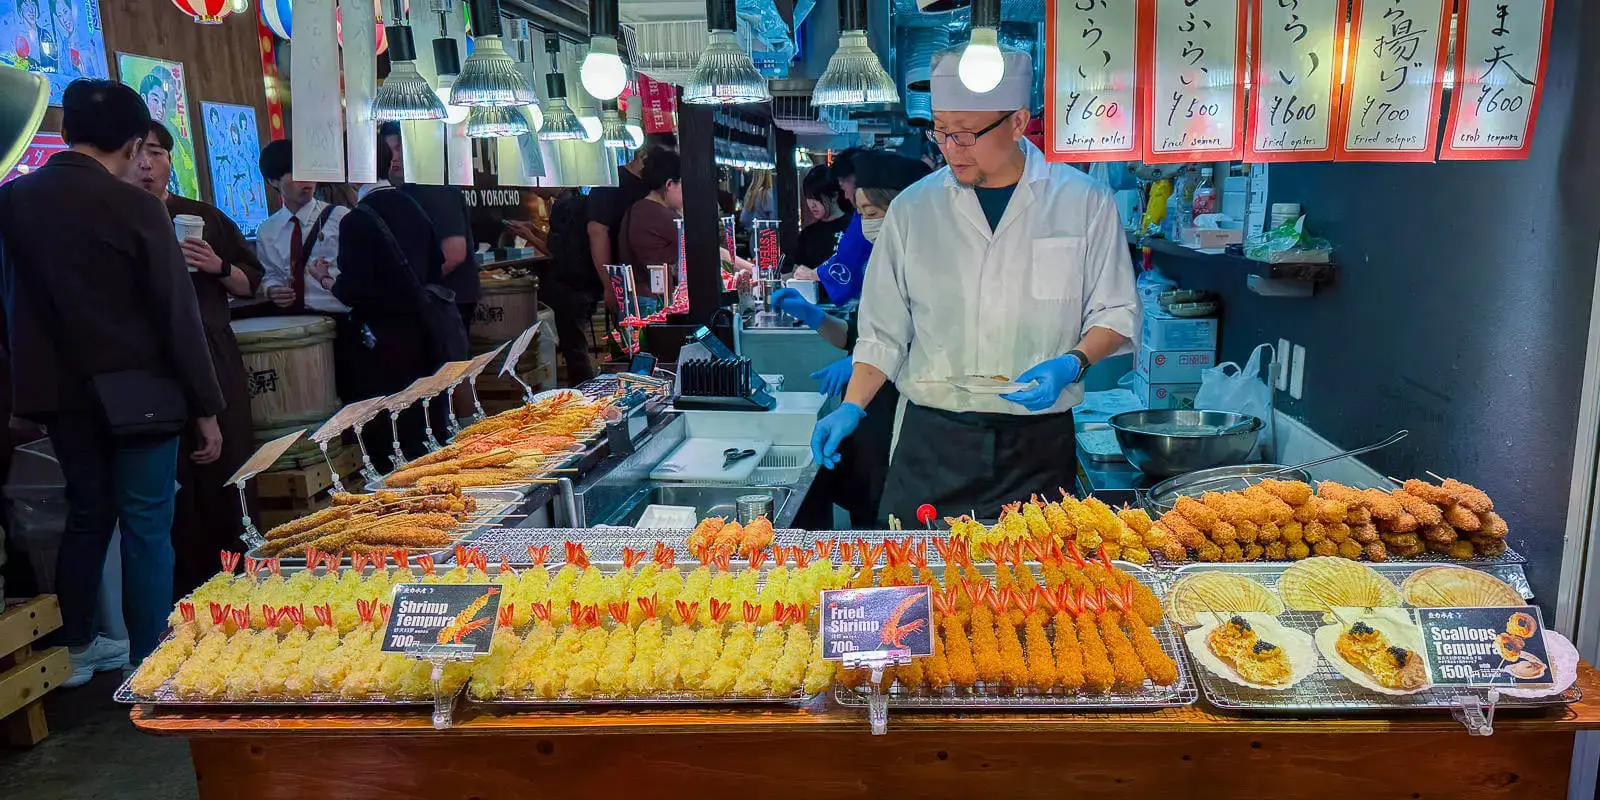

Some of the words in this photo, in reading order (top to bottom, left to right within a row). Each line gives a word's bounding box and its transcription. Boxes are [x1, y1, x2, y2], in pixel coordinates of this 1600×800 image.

[1178, 0, 1212, 85] ふらい
[1065, 91, 1118, 126] ¥600
[1168, 91, 1219, 127] ¥500
[1475, 85, 1524, 117] ¥600
[1270, 95, 1317, 127] ¥600
[1360, 95, 1411, 128] ¥700
[1263, 131, 1287, 148] Fried
[1353, 131, 1381, 145] Fried
[480, 189, 520, 206] YOKOCHO
[398, 600, 449, 615] Shrimp
[830, 606, 865, 620] Fried
[396, 613, 457, 627] Tempura
[830, 619, 880, 633] Shrimp
[1430, 626, 1497, 642] Scallops
[1433, 641, 1501, 656] Tempura
